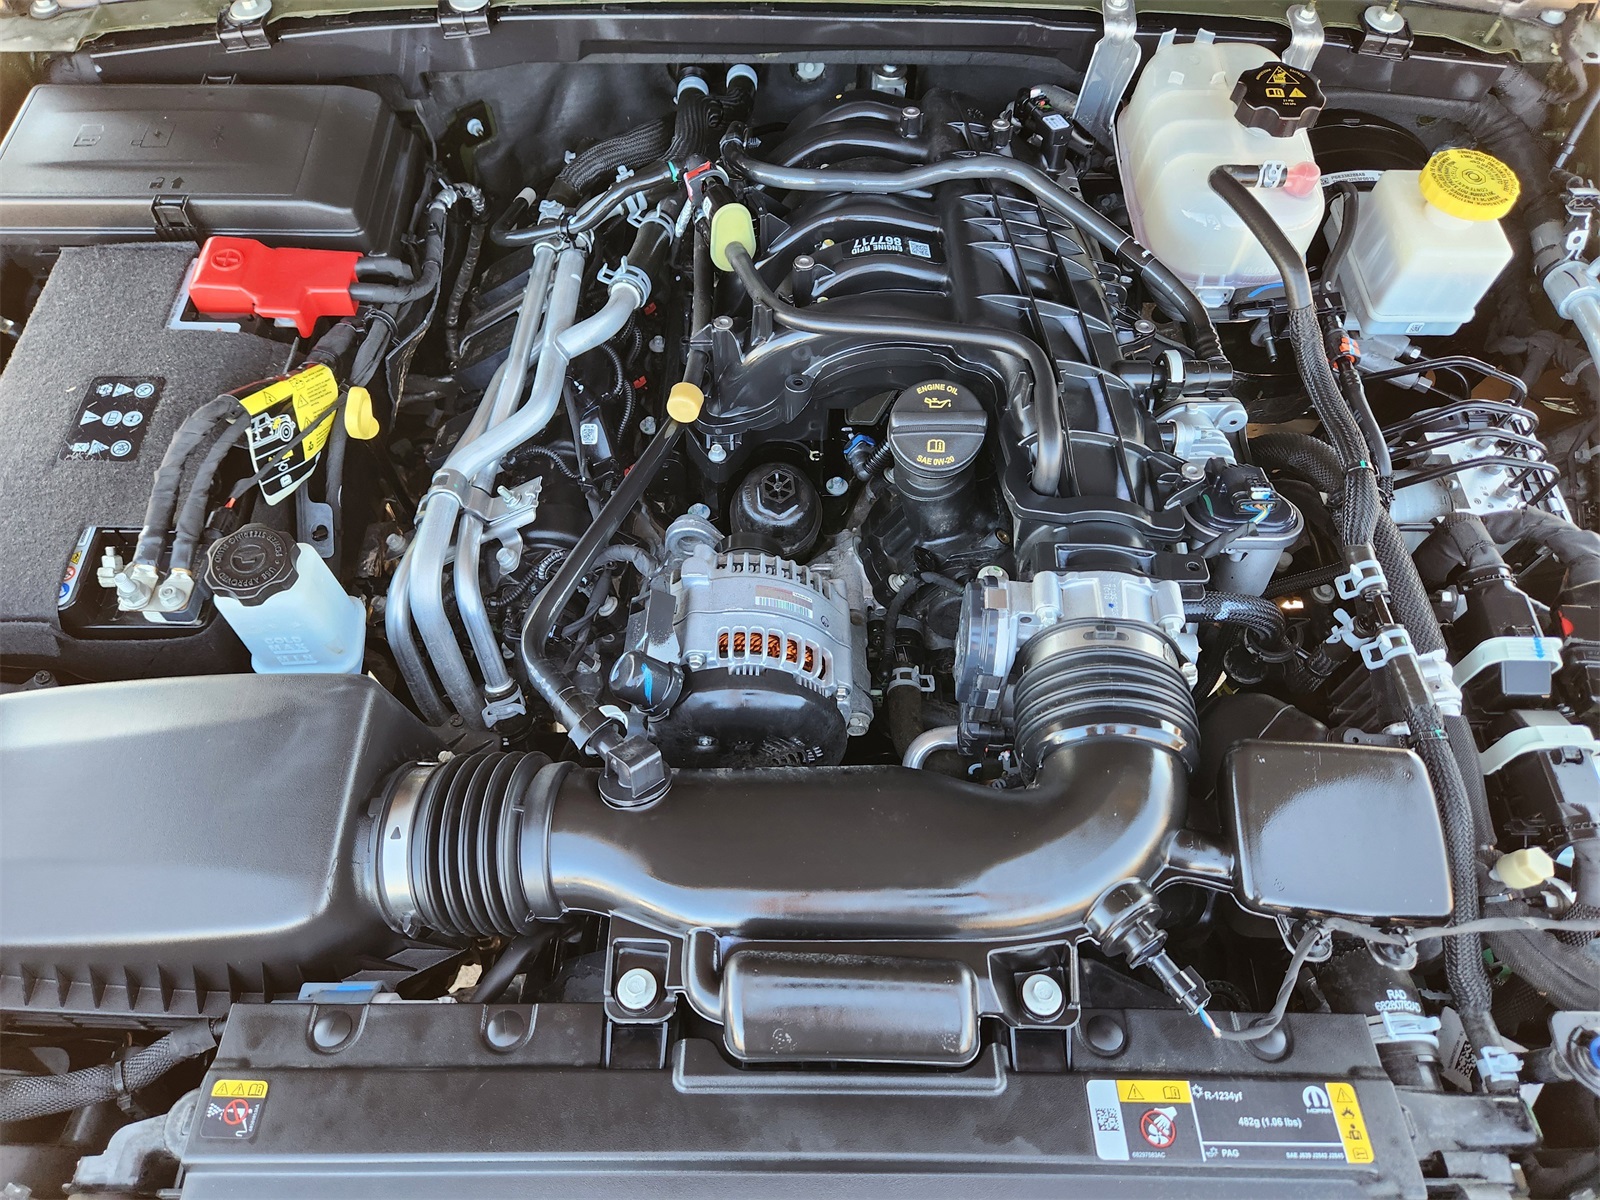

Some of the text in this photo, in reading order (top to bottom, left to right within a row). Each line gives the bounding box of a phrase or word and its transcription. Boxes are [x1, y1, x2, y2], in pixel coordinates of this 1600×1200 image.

[853, 235, 902, 249] 867717
[851, 244, 903, 255] ENGINE RFID
[916, 383, 959, 396] ENGINE OIL
[916, 454, 955, 466] SAE 0W-20
[214, 530, 283, 563] POWER STEERING FLUID
[218, 566, 277, 587] USE APPROVED
[1386, 989, 1407, 1000] RAD
[1204, 1091, 1243, 1103] R-1234yf
[1238, 1116, 1303, 1129] 482g (1.06 lbs)
[1221, 1149, 1240, 1158] PAG
